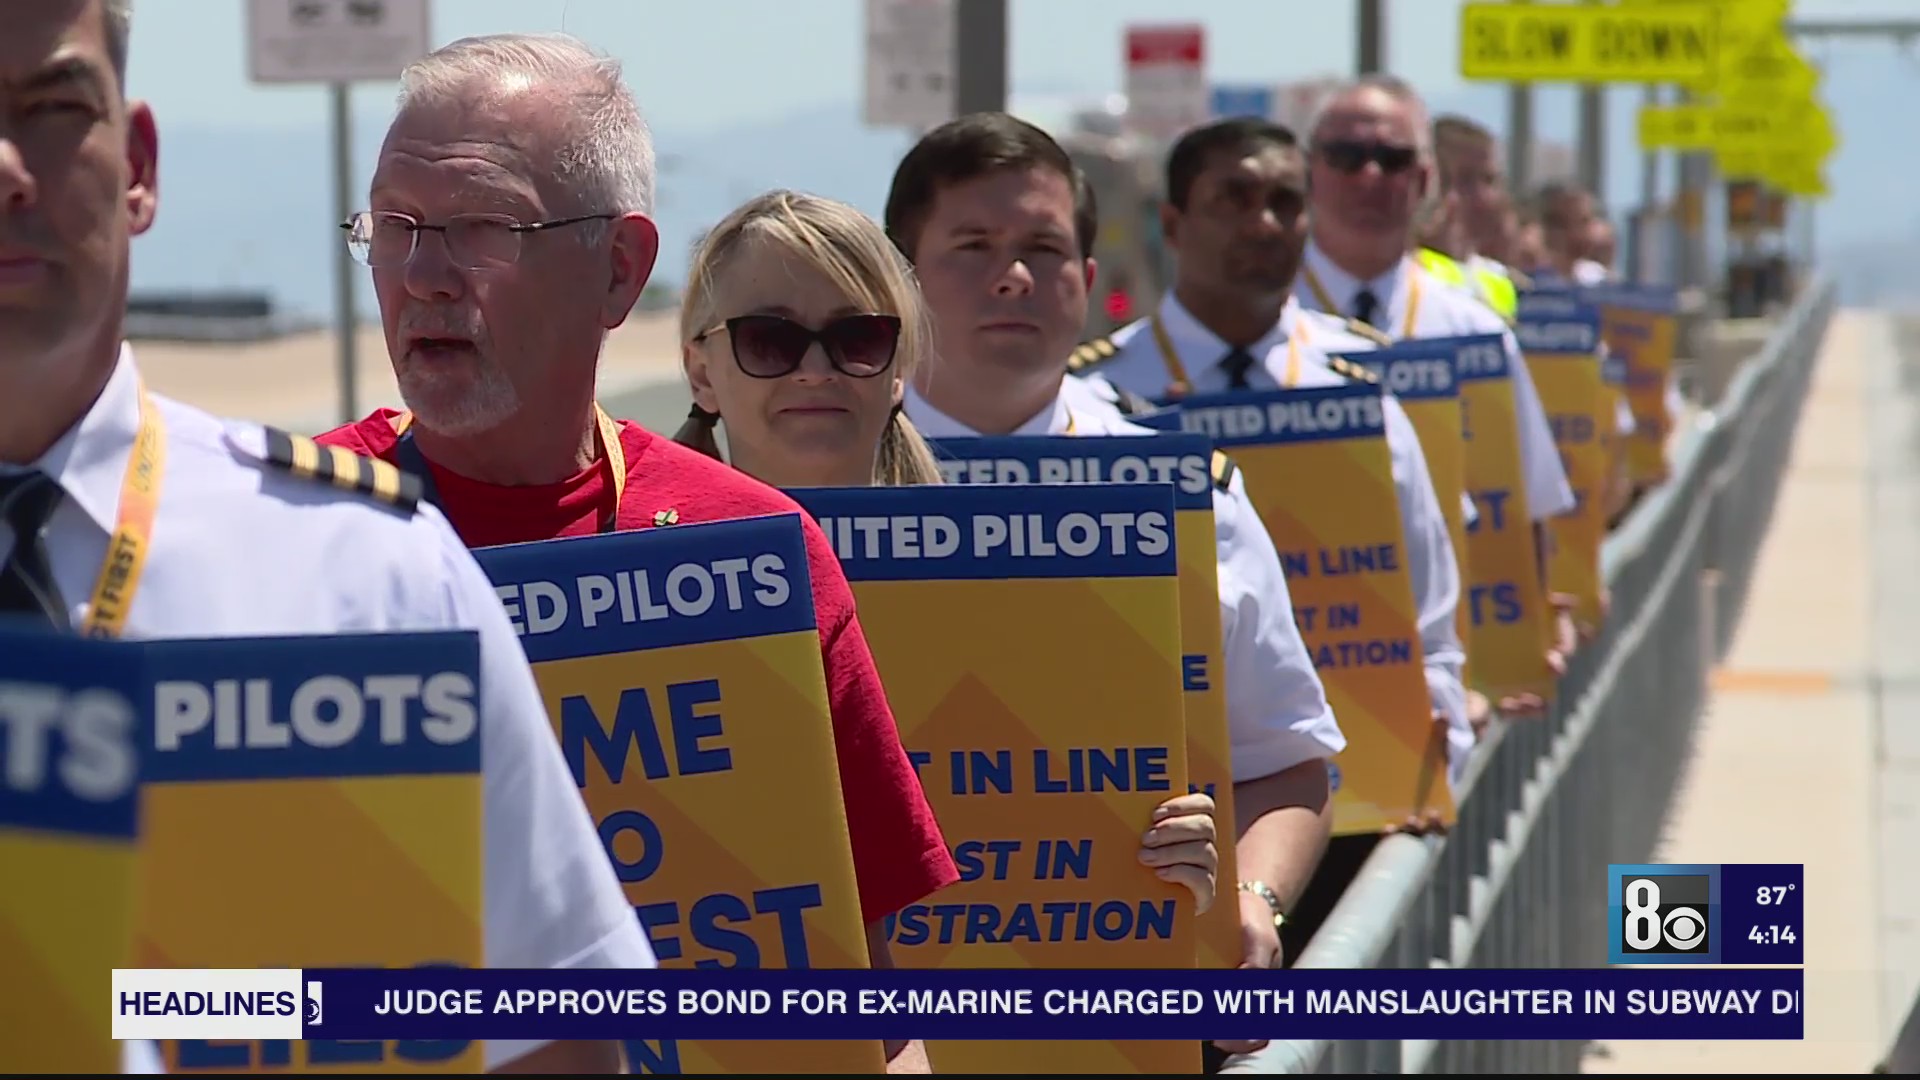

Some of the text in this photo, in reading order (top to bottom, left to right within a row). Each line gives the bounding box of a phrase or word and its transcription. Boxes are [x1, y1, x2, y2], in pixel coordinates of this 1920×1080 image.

[1269, 397, 1383, 435] PILOTS
[972, 511, 1170, 558] PILOTS
[101, 532, 138, 608] FIRST
[1319, 544, 1398, 577] LINE
[576, 554, 790, 628] PILOTS
[1328, 603, 1361, 630] IN
[1182, 655, 1210, 691] E
[154, 671, 478, 752] PILOTS
[561, 679, 733, 788] ME
[0, 682, 138, 803] TS
[951, 751, 1013, 795] IN
[1033, 747, 1171, 794] LINE
[1033, 839, 1093, 881] IN
